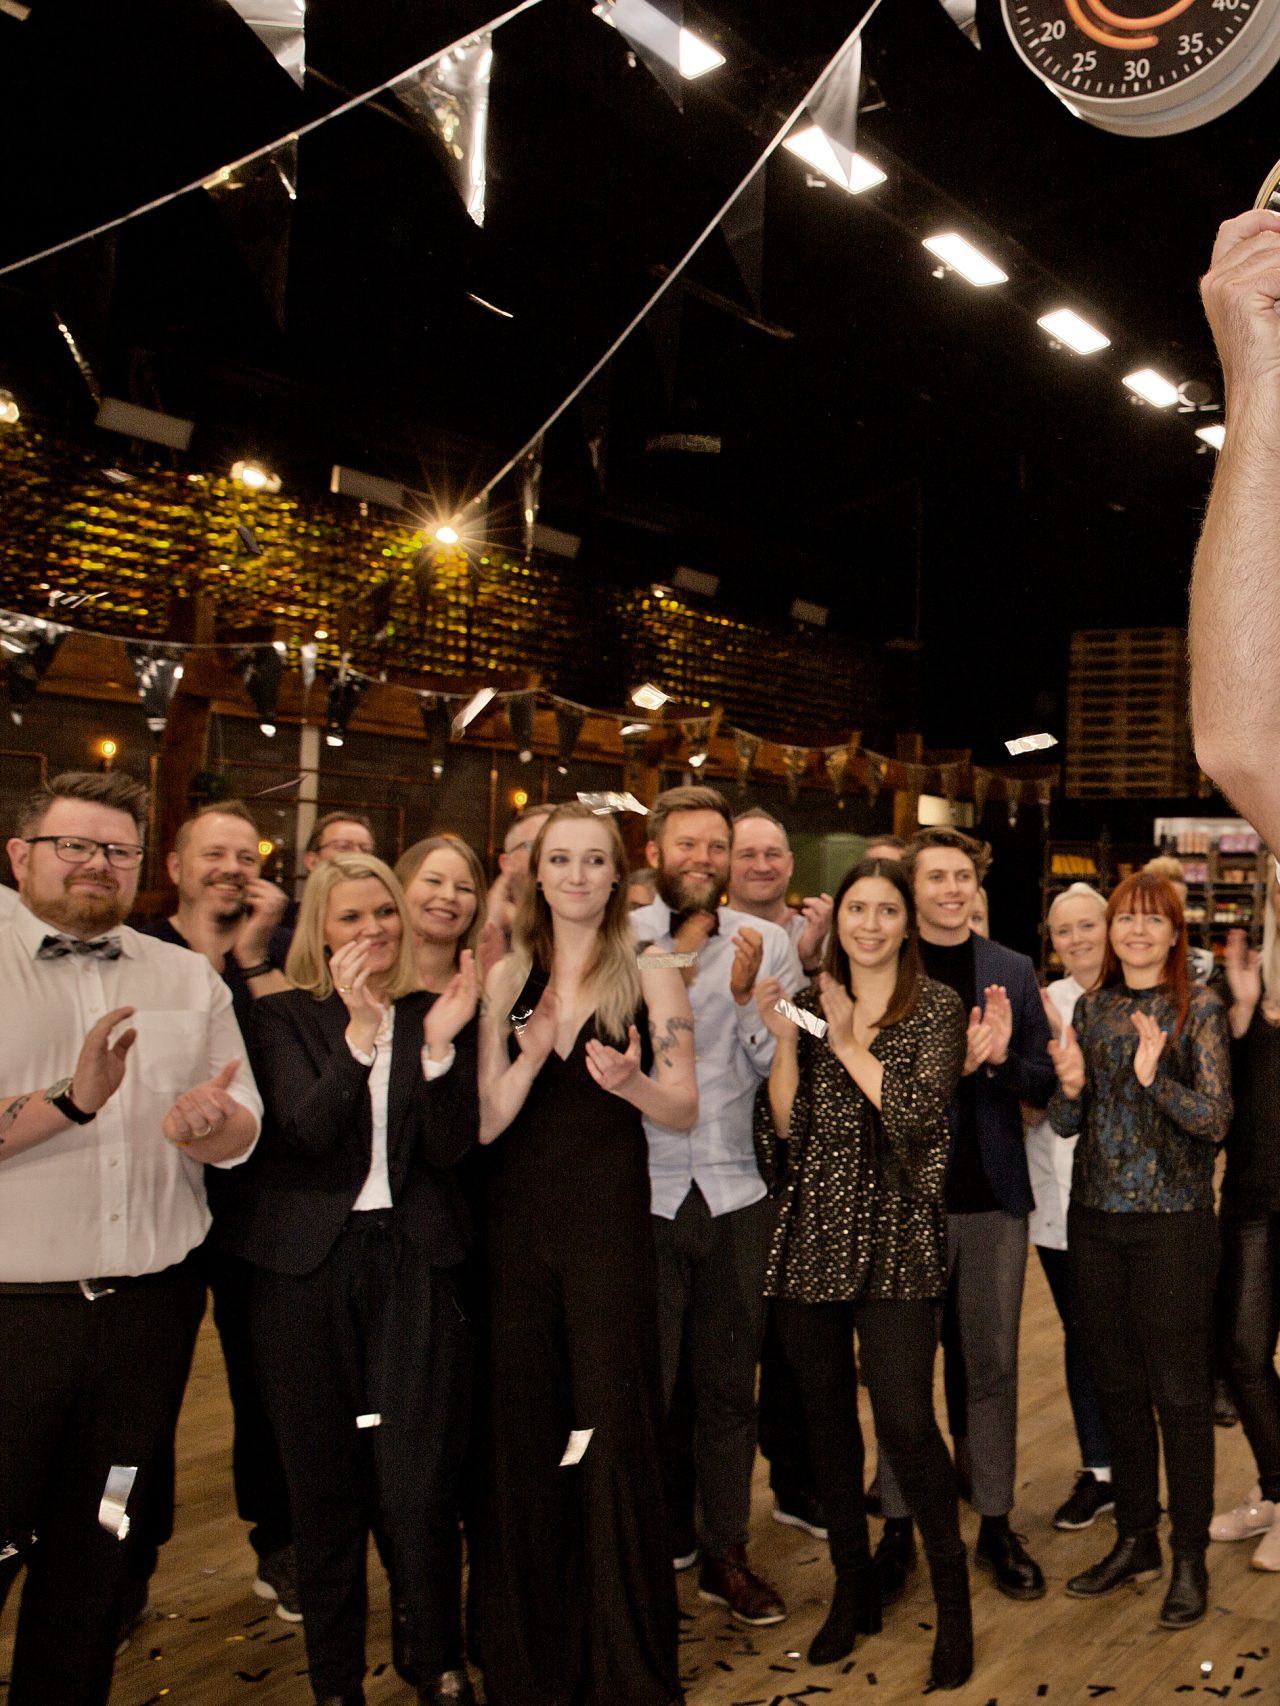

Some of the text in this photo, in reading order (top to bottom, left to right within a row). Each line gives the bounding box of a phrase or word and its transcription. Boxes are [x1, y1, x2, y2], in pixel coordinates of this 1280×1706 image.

[1040, 19, 1066, 43] 20
[1177, 32, 1204, 56] 35
[1071, 50, 1098, 74] 25
[1123, 58, 1150, 82] 30
